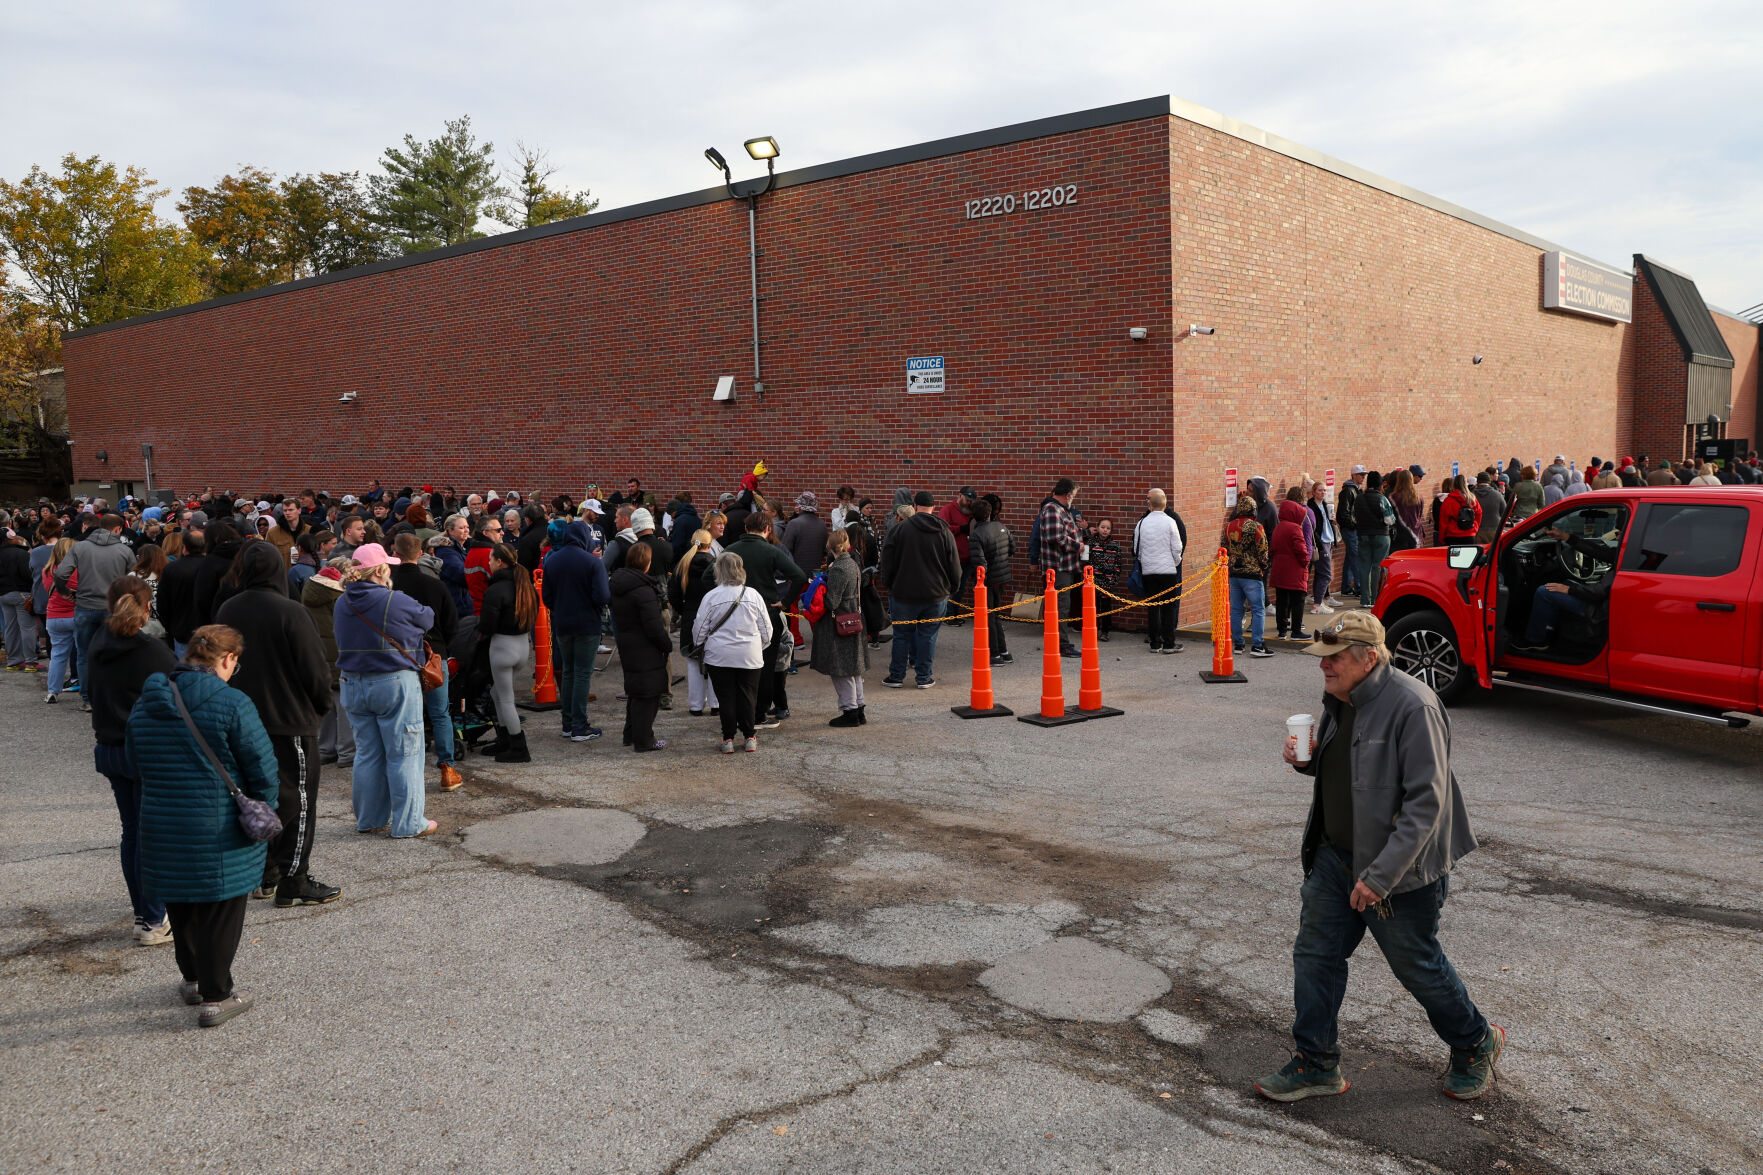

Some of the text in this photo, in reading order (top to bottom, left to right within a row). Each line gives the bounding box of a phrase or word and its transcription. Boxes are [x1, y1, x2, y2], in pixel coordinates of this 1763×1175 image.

[965, 185, 1077, 219] 12220-12202
[1567, 282, 1596, 306] ELECTION
[1597, 292, 1629, 315] COMMISSION
[910, 358, 941, 369] NOTICE
